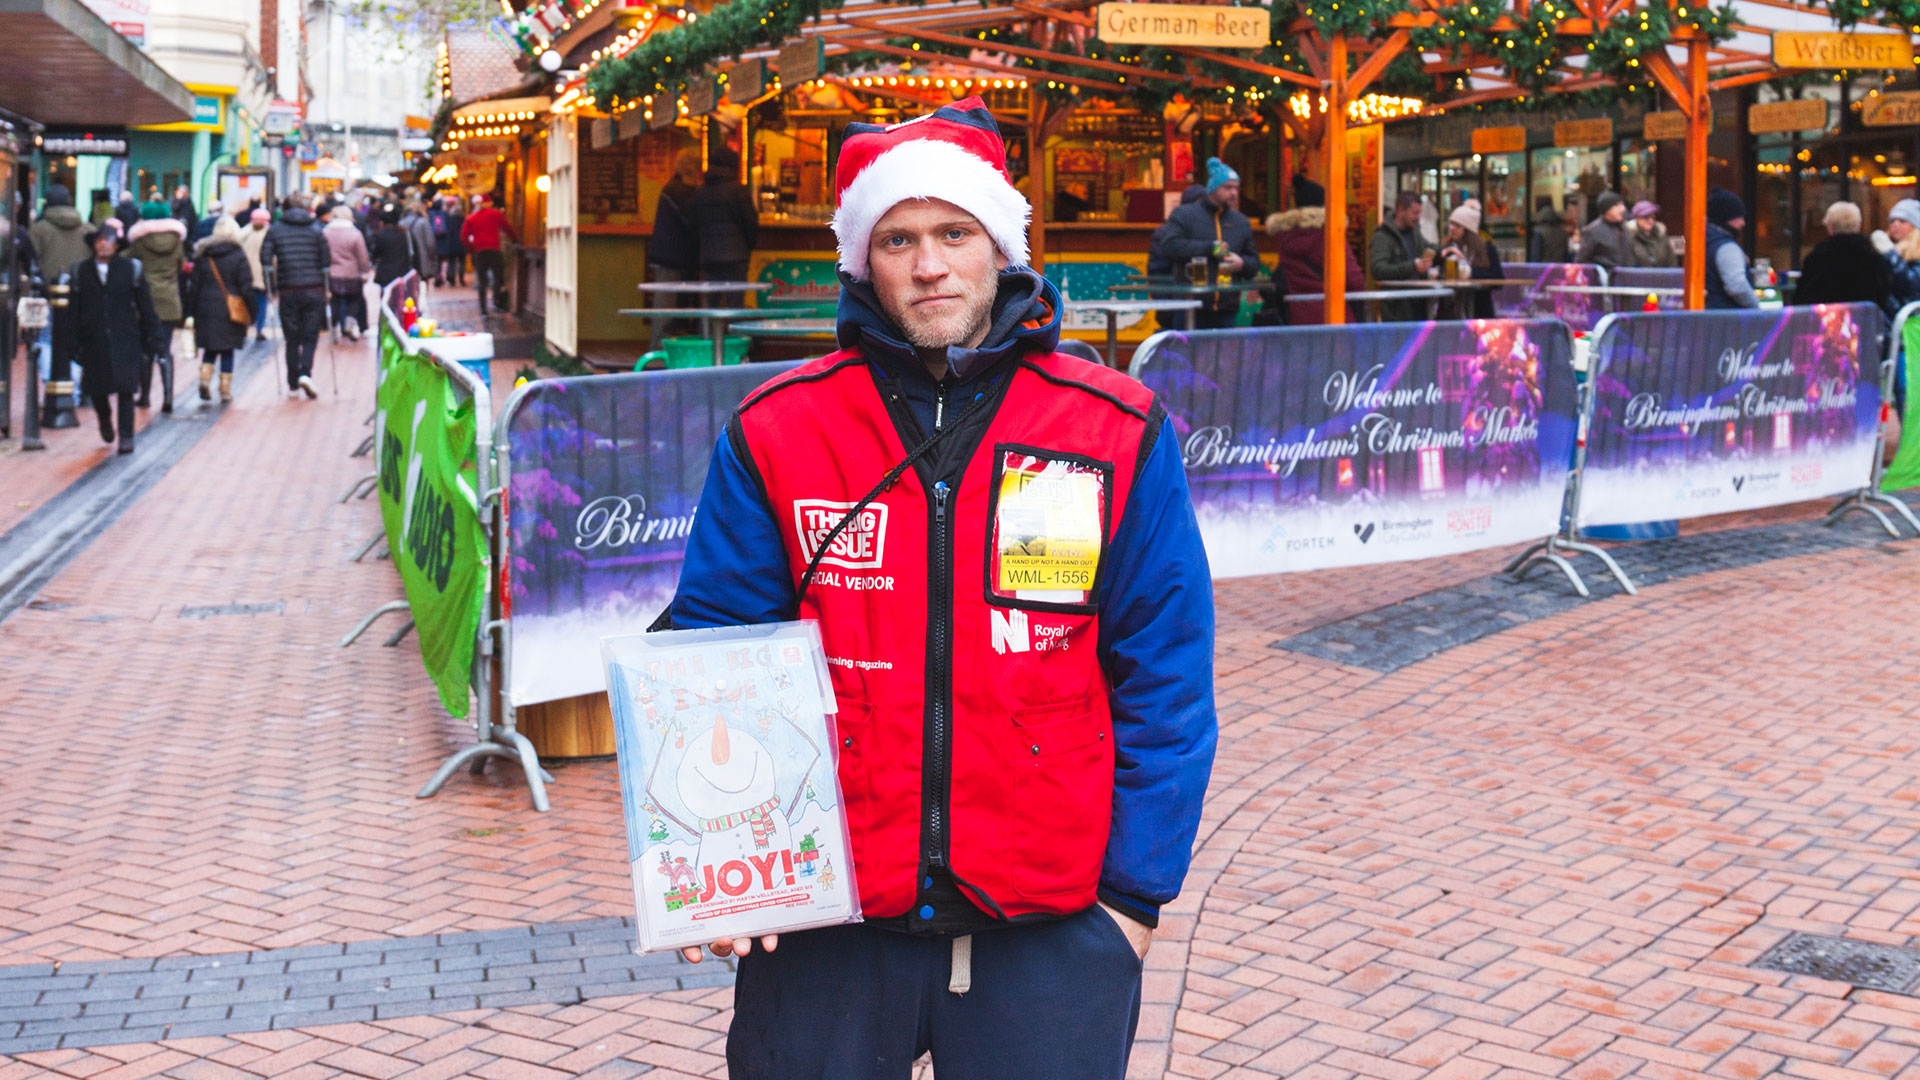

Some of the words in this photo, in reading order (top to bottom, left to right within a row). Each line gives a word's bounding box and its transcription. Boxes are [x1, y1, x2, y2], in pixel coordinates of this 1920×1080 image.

[1108, 9, 1198, 37] German
[1215, 12, 1262, 36] Beer
[1793, 37, 1894, 60] Weißbier
[1717, 341, 1780, 382] Welcome
[1783, 358, 1795, 376] to
[1323, 363, 1424, 412] Welcome
[1425, 382, 1443, 405] to
[1624, 392, 1740, 436] Birmingham's
[1741, 383, 1808, 416] Christmas
[1183, 424, 1359, 478] Birmingham's
[1361, 412, 1465, 454] Christmas
[1468, 405, 1538, 445] Markets
[574, 493, 697, 551] Birmi
[805, 510, 847, 532] THE
[848, 511, 876, 532] BIG
[1382, 517, 1433, 532] Birmingham
[1447, 517, 1493, 532] MONSTER
[808, 529, 873, 559] ISSUE
[845, 576, 895, 590] VENDOR
[1008, 570, 1089, 584] WML-1556
[1034, 624, 1064, 640] Royal
[1035, 638, 1048, 651] of
[645, 655, 705, 682] THE
[727, 645, 772, 671] BIG
[827, 656, 853, 669] inning
[699, 849, 796, 903] JOY!
[703, 899, 728, 908] DESIGNED
[732, 903, 760, 912] CHRISTMAS
[760, 900, 776, 908] COVER
